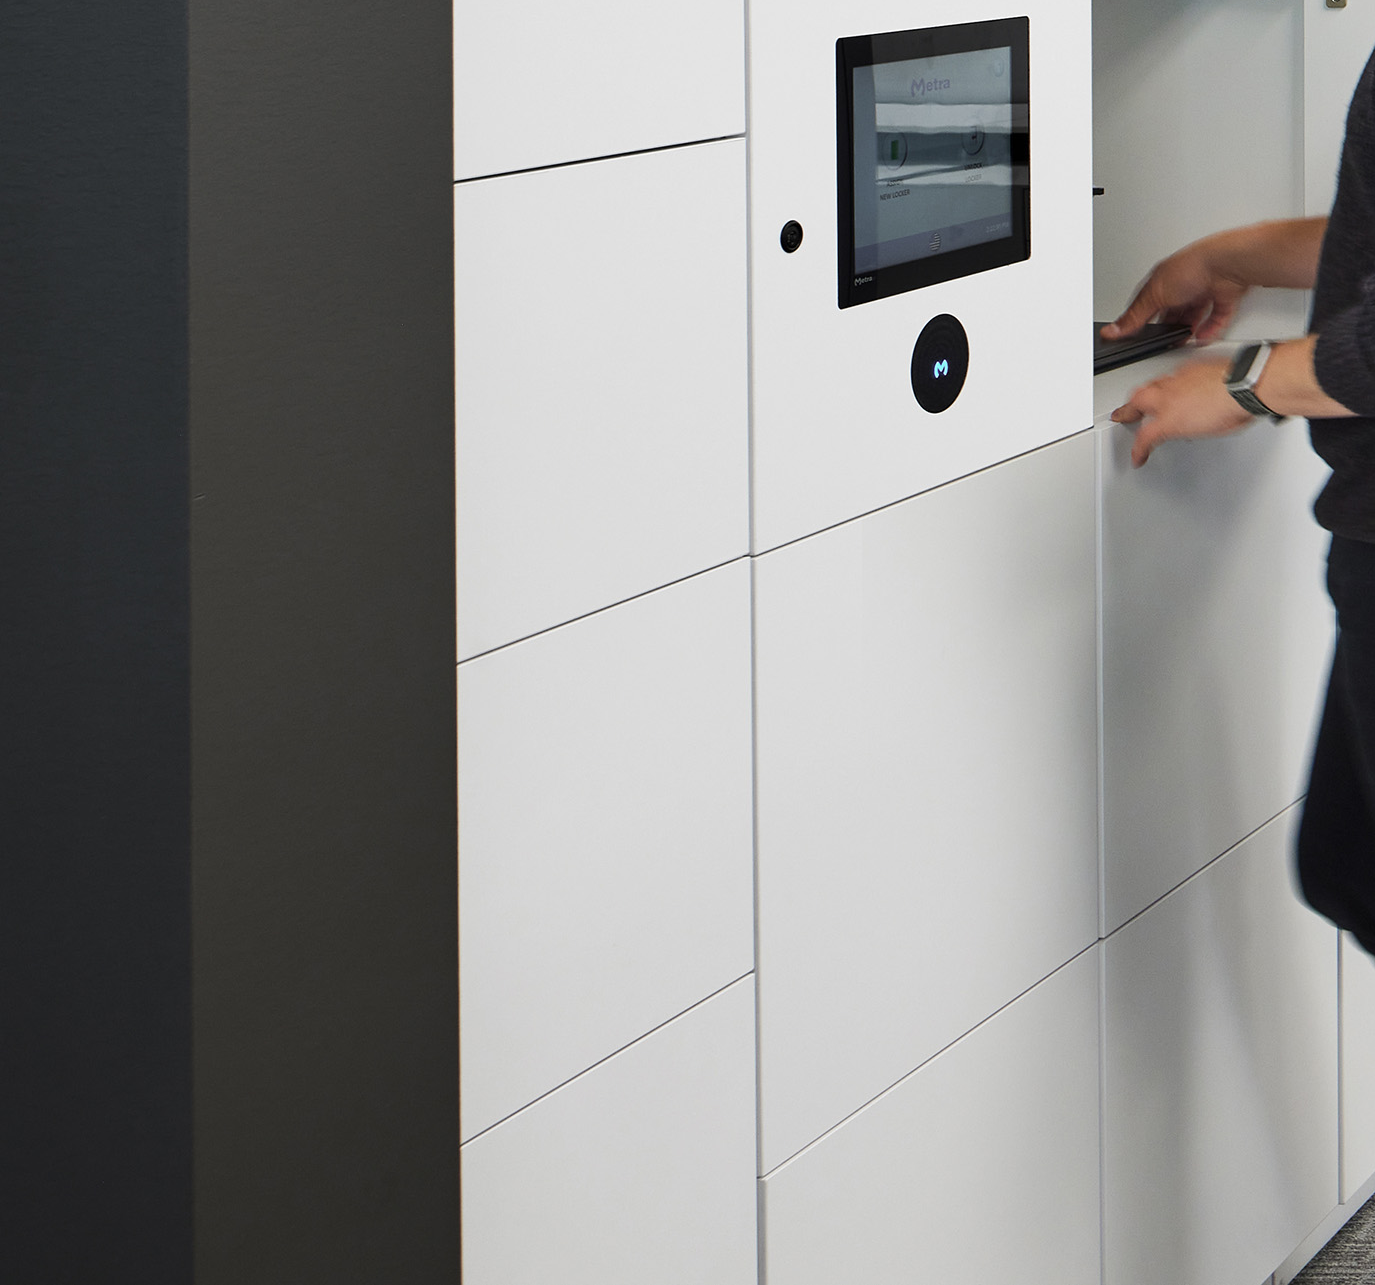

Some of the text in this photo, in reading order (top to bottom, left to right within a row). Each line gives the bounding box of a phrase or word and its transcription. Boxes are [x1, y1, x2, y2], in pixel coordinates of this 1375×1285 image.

[911, 77, 950, 98] Metra
[879, 188, 911, 201] NEW LOCKER
[854, 276, 873, 287] Metra
